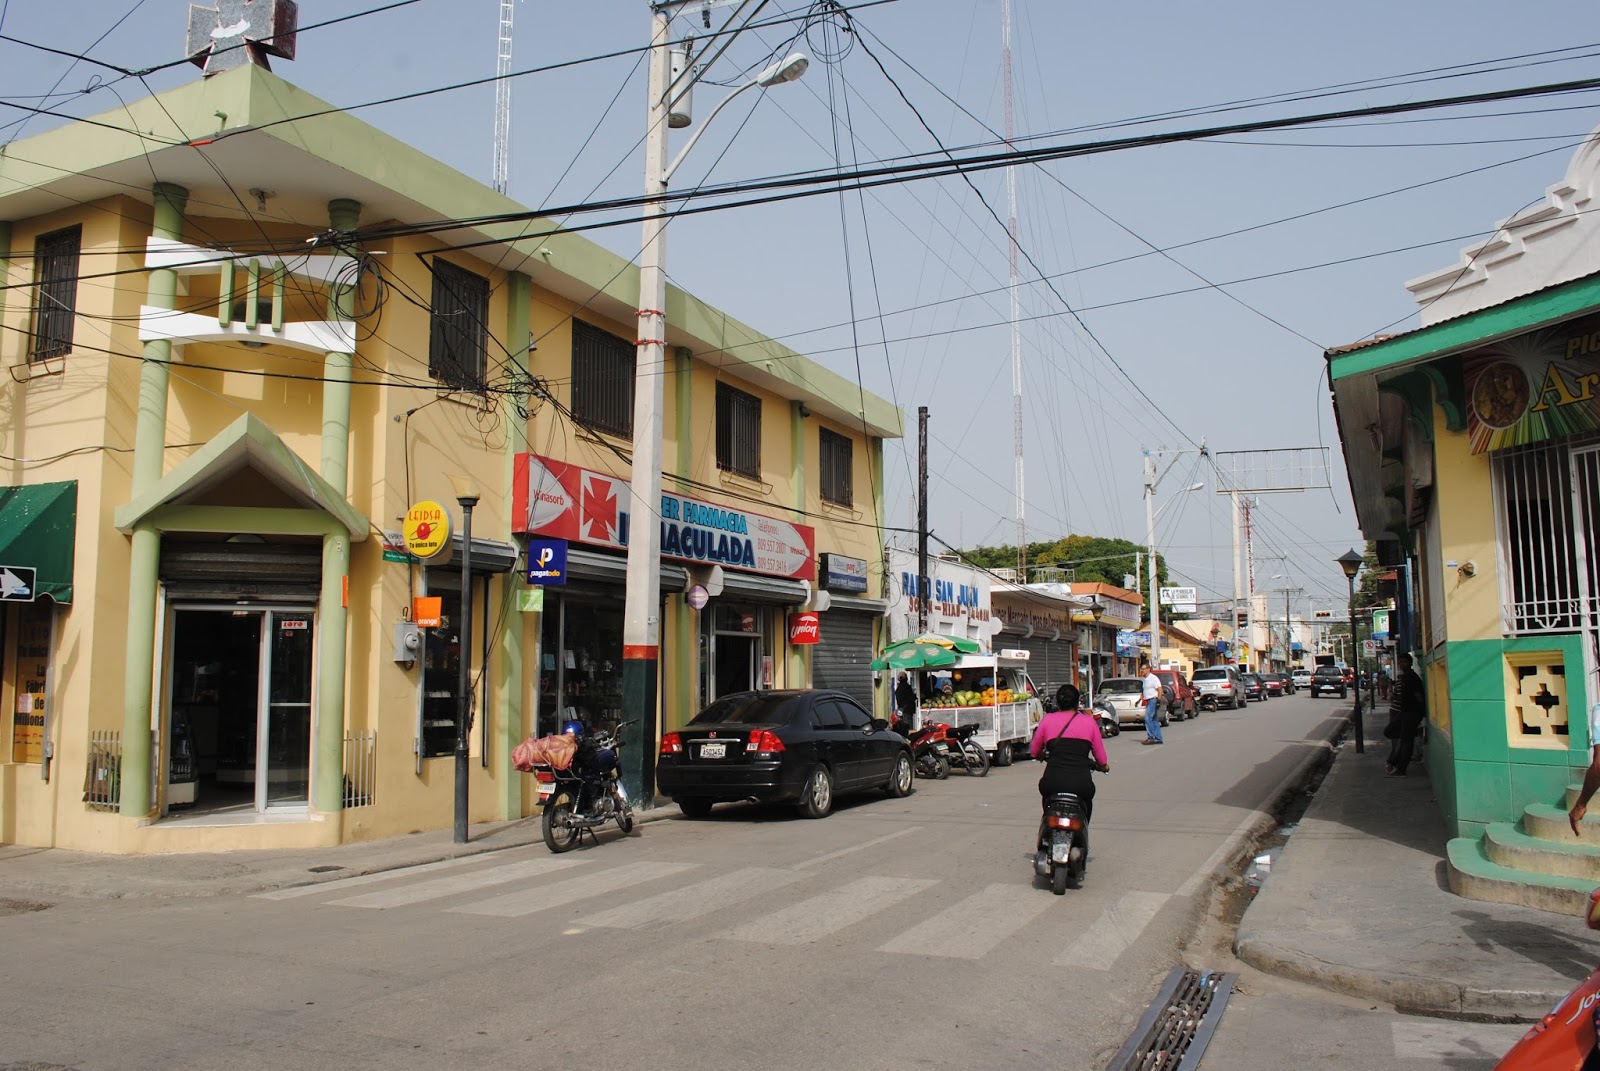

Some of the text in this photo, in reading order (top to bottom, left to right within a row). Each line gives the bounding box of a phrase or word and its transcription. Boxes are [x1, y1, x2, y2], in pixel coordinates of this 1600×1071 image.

[533, 489, 564, 506] Winasorb
[408, 510, 441, 522] LEIDSA
[683, 501, 748, 535] FARMACIA
[530, 570, 561, 578] pagatodo
[935, 579, 954, 604] SAN
[34, 697, 45, 710] de
